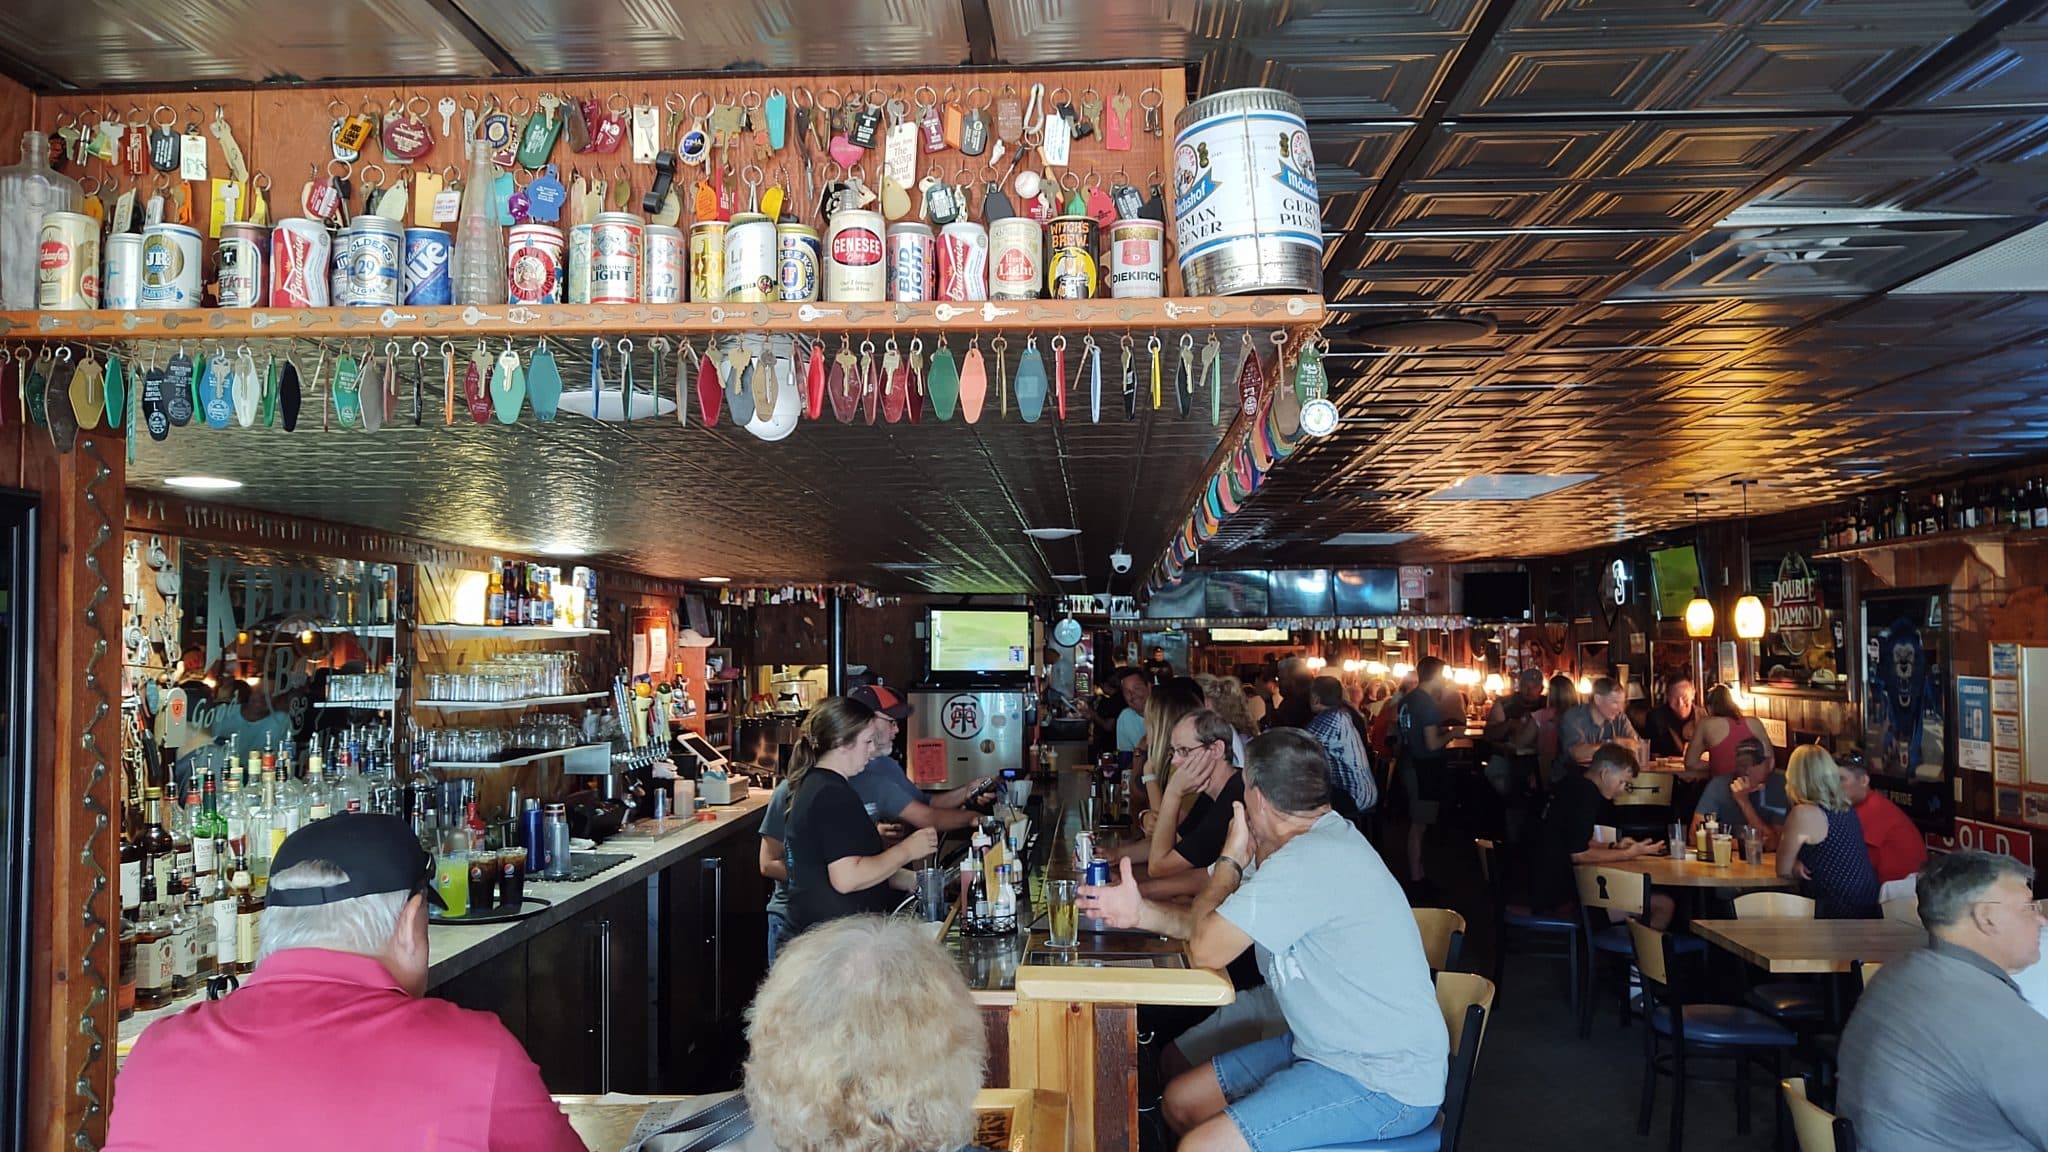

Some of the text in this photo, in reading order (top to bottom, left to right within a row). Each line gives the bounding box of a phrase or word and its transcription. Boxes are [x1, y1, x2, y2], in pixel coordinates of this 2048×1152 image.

[1051, 221, 1090, 235] WITCH'S
[1178, 206, 1217, 235] RMAN
[350, 237, 395, 263] OLDERS
[833, 236, 881, 254] GENESEE
[358, 258, 376, 275] 29
[593, 263, 633, 271] udweiser
[899, 248, 911, 293] BUD
[911, 242, 922, 301] LIGHT
[1000, 263, 1032, 277] Light
[1112, 272, 1161, 284] DIEKIRCH
[1773, 578, 1816, 607] DOUBLE
[1770, 606, 1822, 633] DIAMOND
[192, 690, 241, 729] Good
